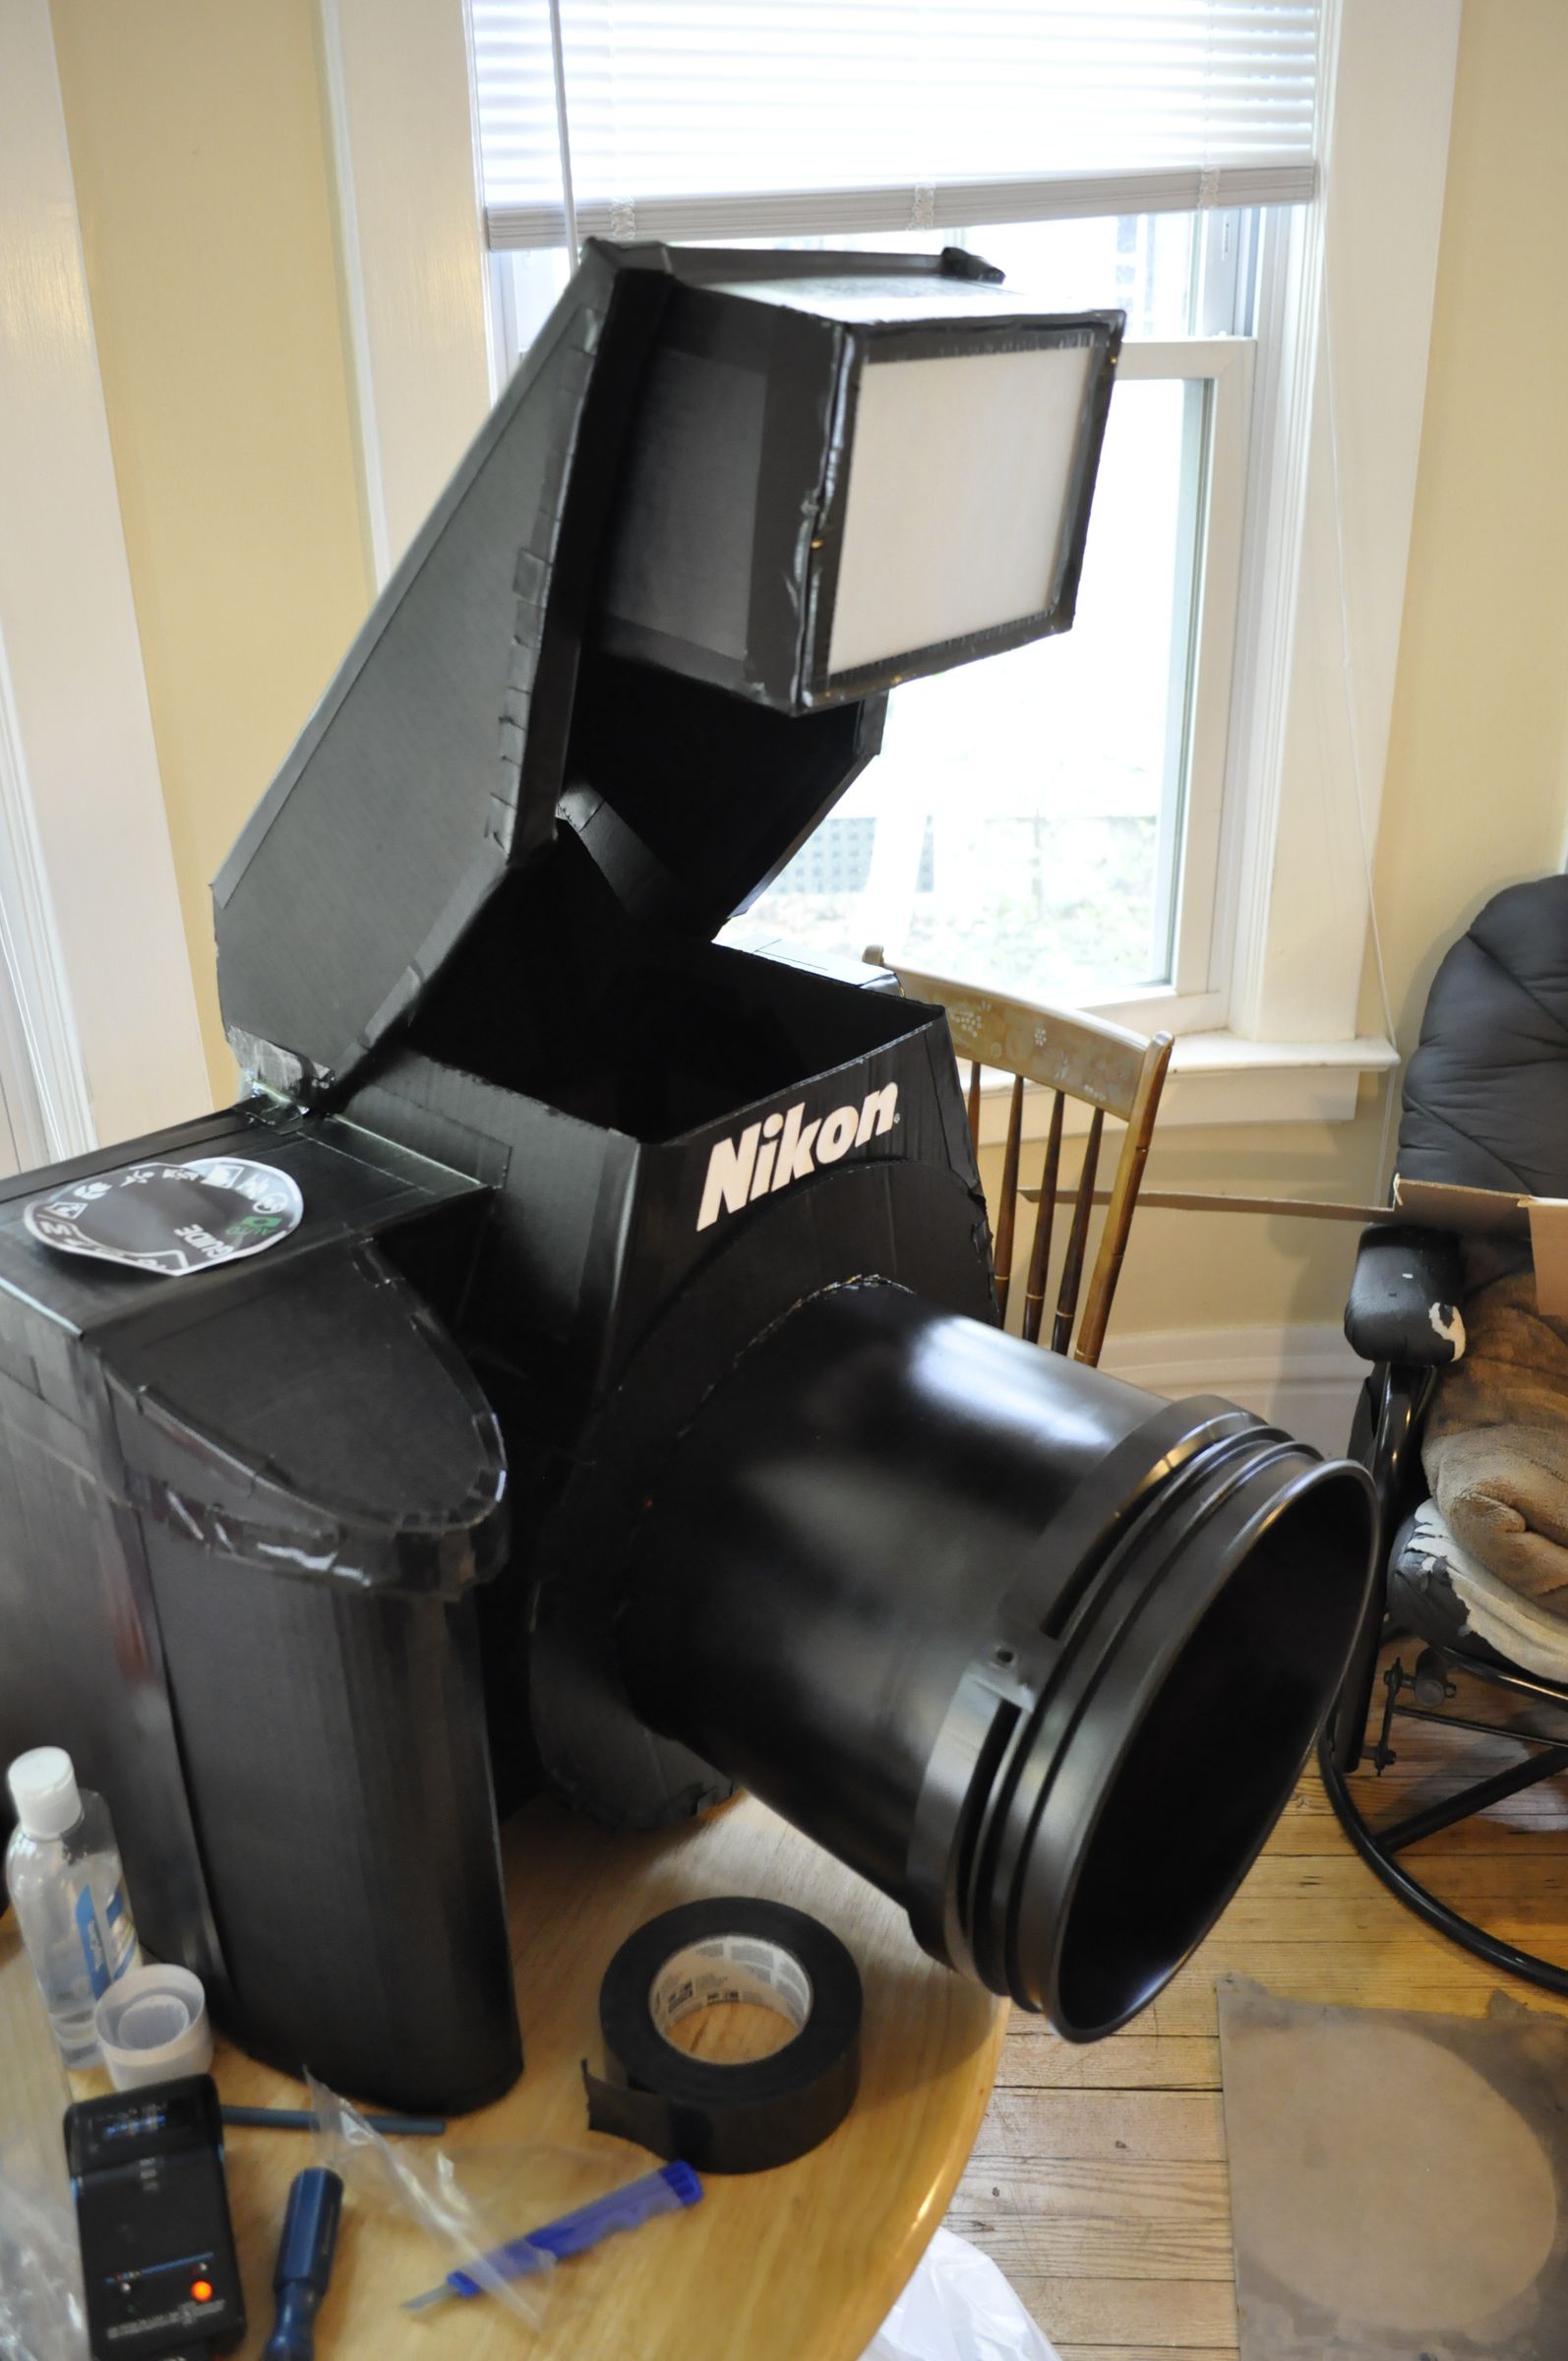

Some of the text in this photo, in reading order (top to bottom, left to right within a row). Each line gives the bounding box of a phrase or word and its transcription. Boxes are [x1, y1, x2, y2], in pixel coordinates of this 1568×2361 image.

[696, 1082, 897, 1232] Nikon
[173, 1223, 234, 1258] GUIDE
[225, 1225, 275, 1236] AUTO
